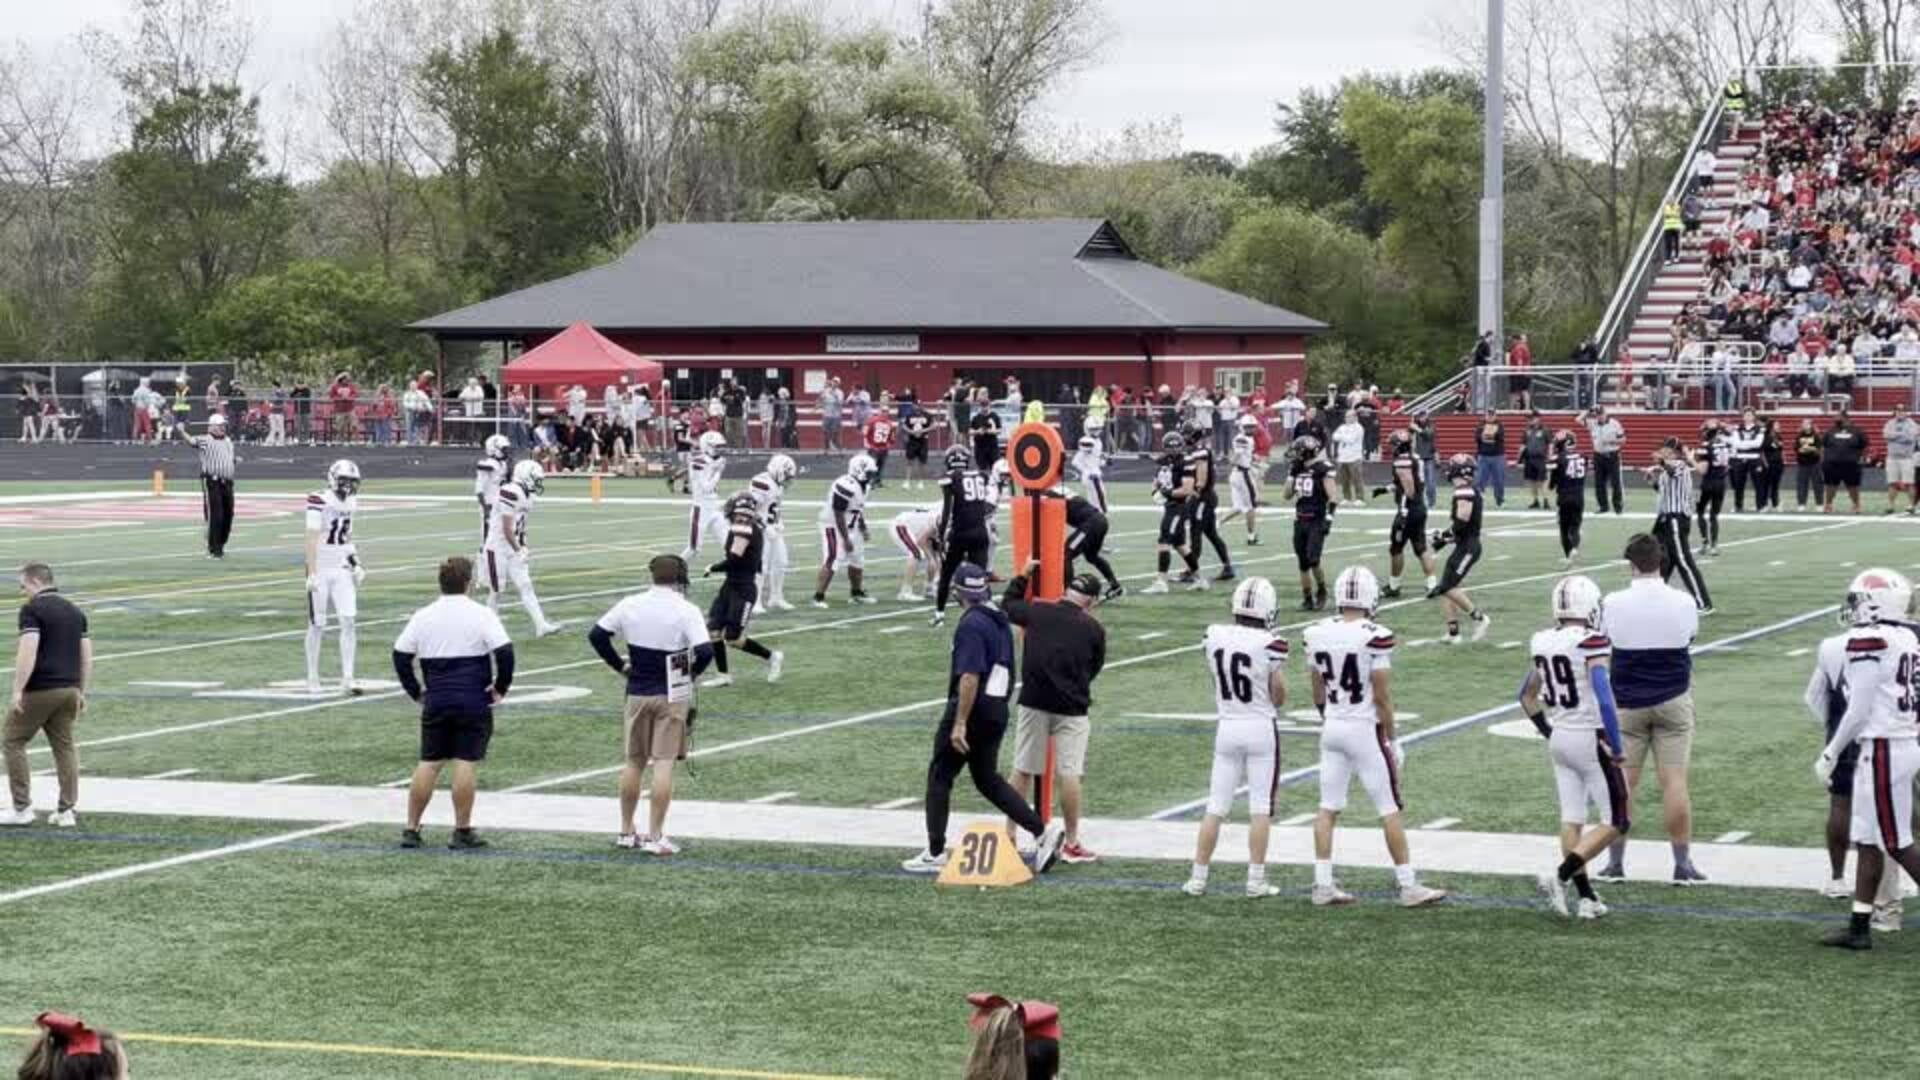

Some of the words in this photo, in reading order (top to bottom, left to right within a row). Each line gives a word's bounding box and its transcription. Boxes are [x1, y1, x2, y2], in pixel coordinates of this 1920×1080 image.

[962, 476, 985, 501] 96
[1566, 458, 1585, 478] 45
[1214, 649, 1253, 704] 16
[1315, 652, 1364, 705] 24
[959, 831, 998, 876] 30
